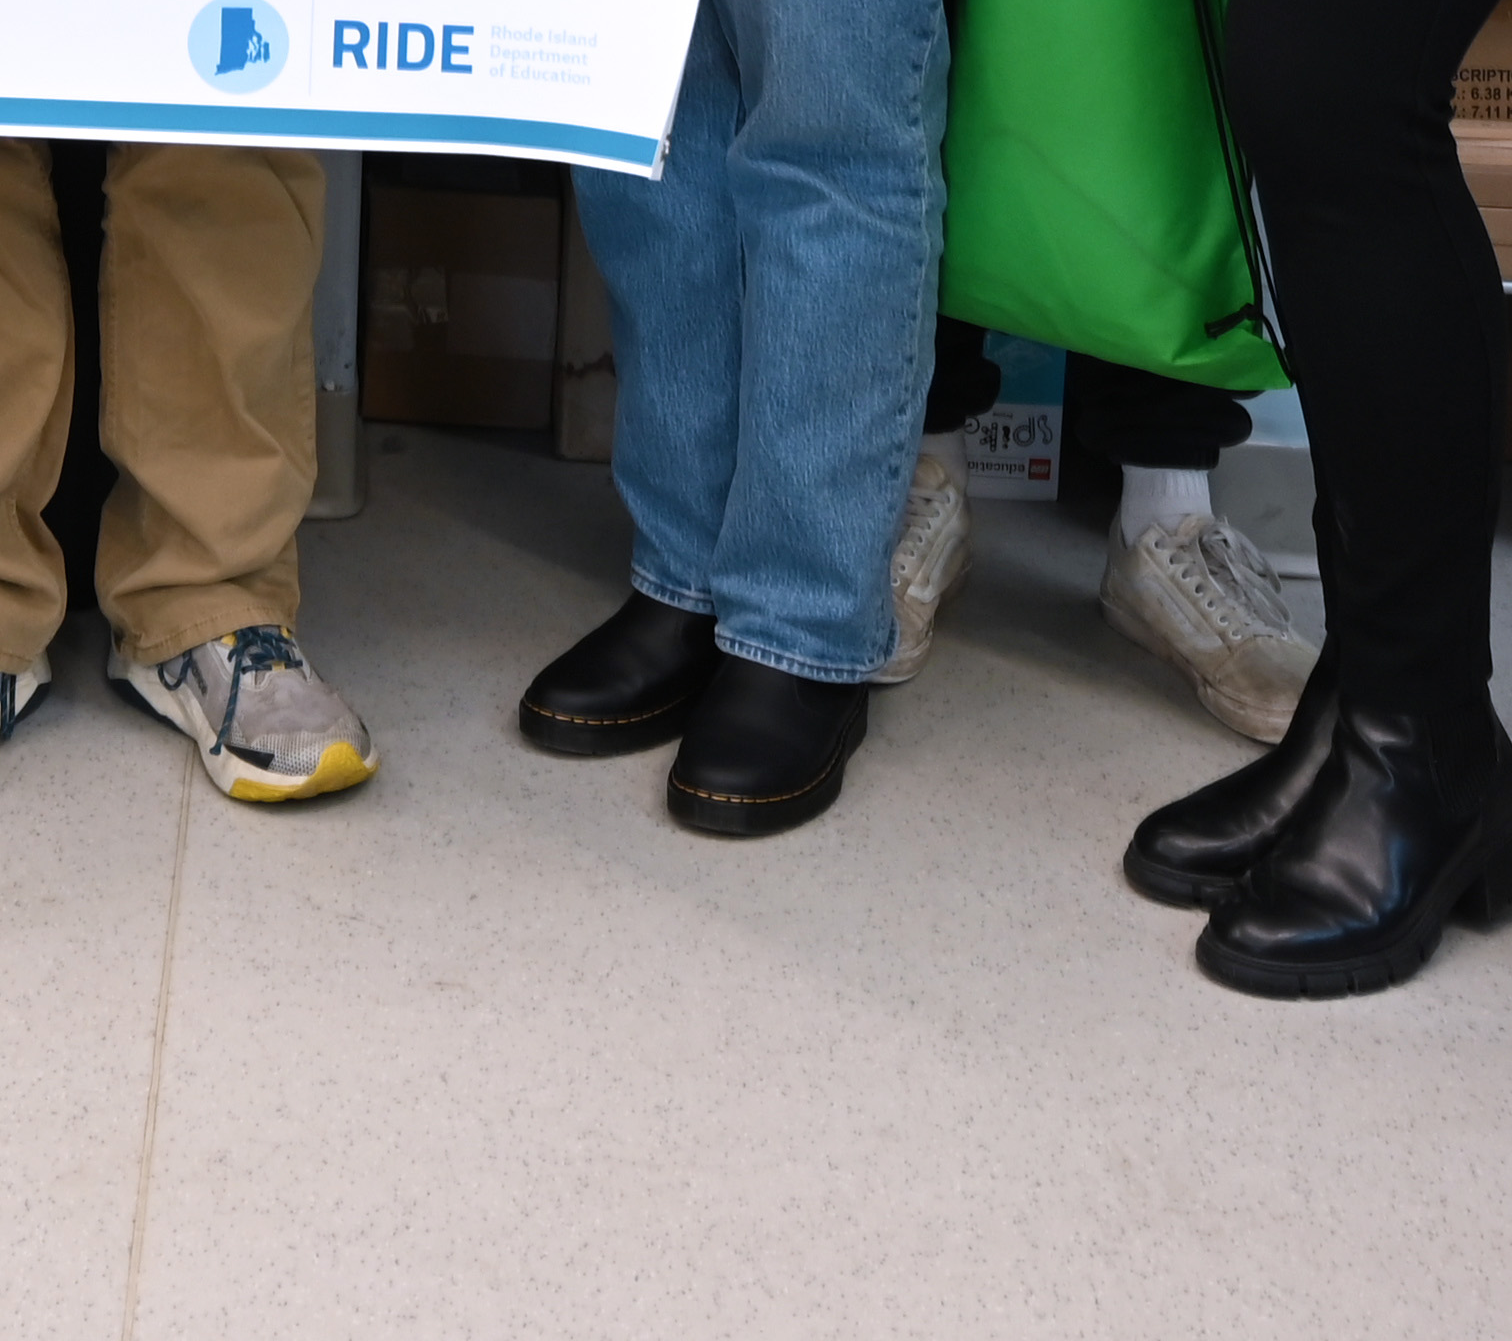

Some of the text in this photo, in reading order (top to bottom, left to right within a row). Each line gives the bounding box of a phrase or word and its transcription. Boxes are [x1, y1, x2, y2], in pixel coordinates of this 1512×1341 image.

[332, 18, 475, 75] RIDE
[490, 25, 598, 48] Rhode Island
[489, 44, 589, 67] Department
[489, 63, 592, 86] of Education
[1470, 88, 1502, 101] 6.38
[1471, 105, 1501, 118] 7.11
[967, 460, 1026, 475] educatio
